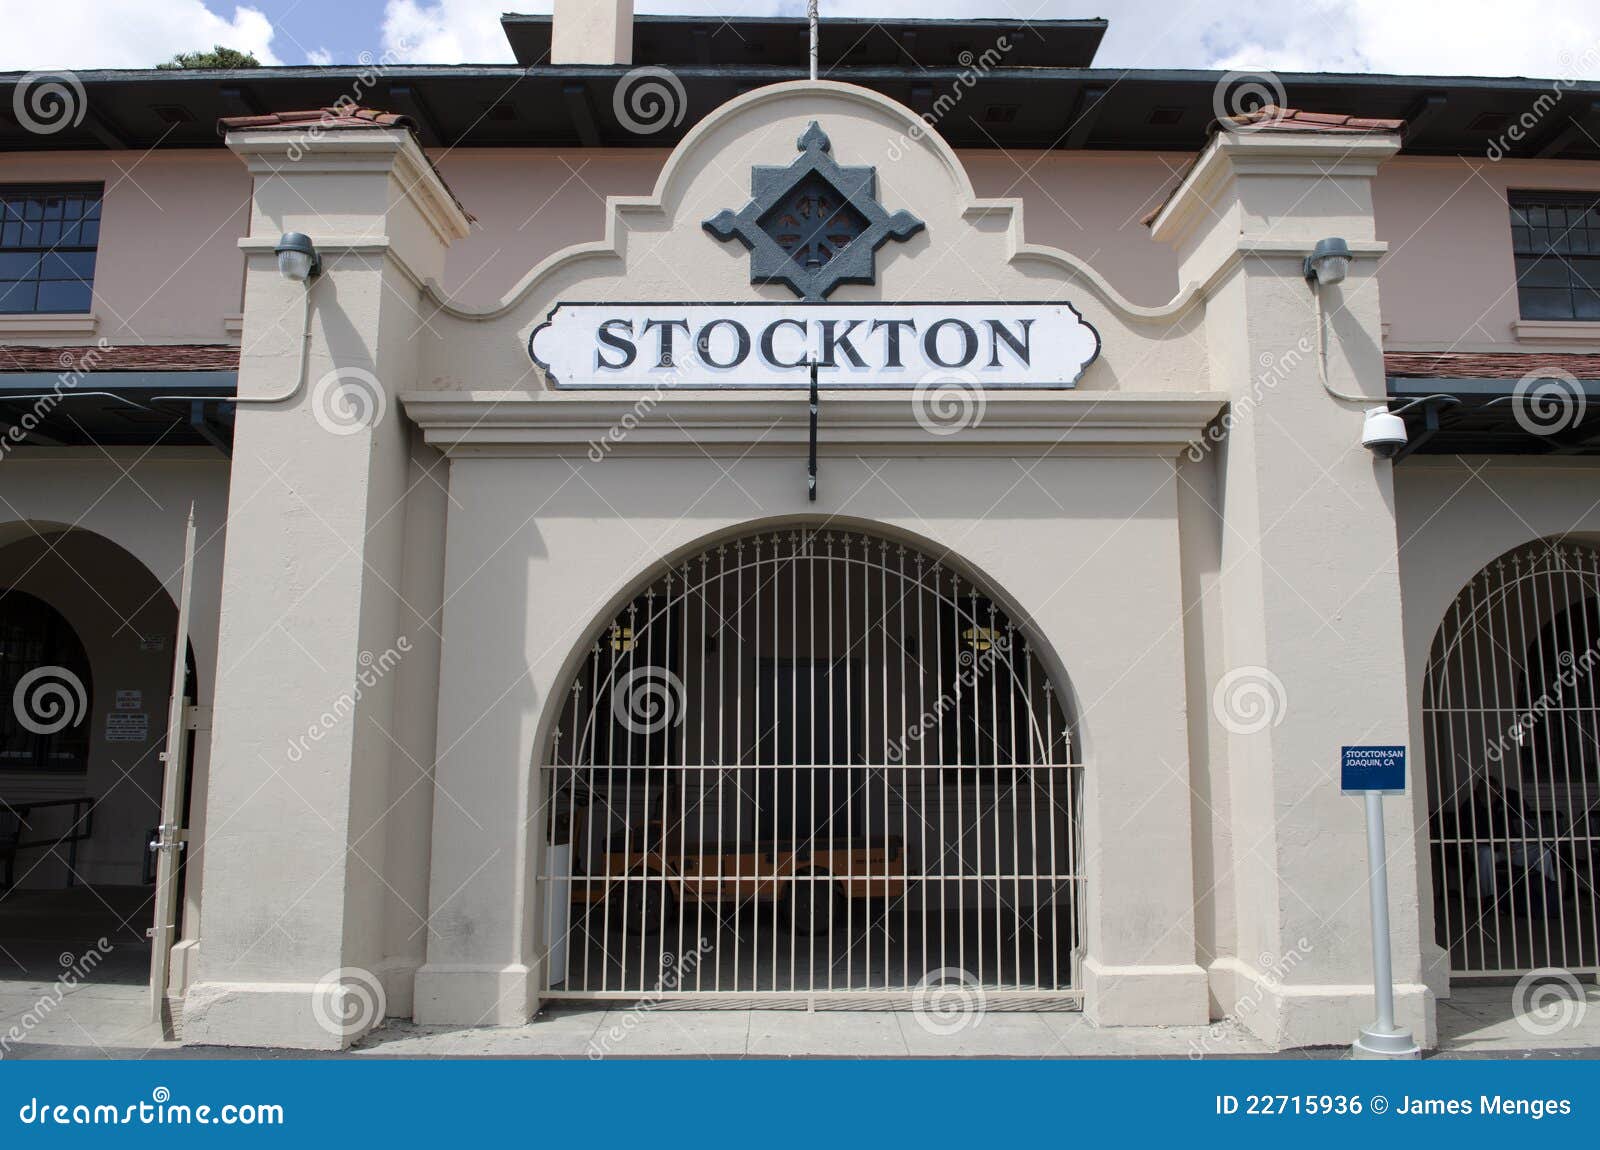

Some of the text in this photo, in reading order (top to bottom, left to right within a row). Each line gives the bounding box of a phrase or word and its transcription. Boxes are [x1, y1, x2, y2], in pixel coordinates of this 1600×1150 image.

[595, 318, 1036, 371] STOCKTON
[1346, 750, 1404, 758] STOCKTON-SAN
[1346, 759, 1382, 767] JOAQUIN,
